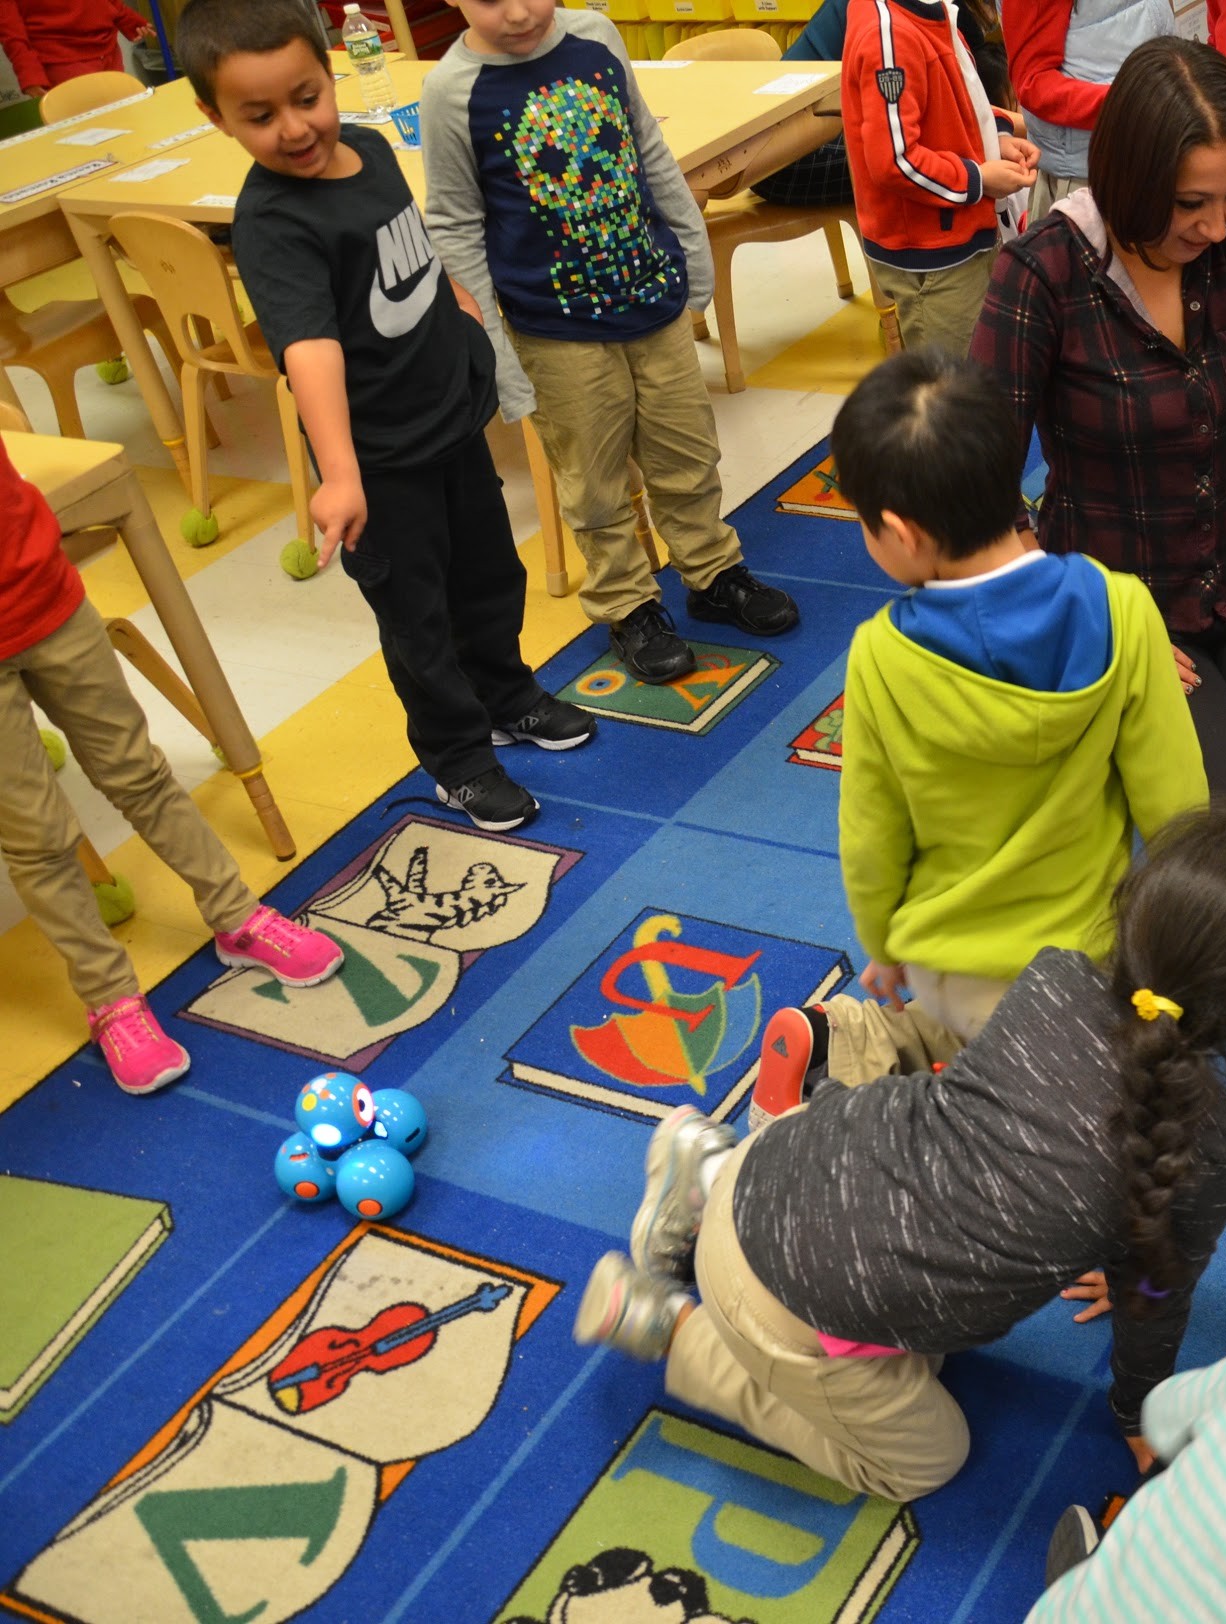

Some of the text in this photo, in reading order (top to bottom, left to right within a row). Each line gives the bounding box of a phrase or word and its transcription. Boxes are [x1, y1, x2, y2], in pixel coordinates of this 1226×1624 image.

[376, 200, 433, 290] NIK
[600, 941, 763, 1033] U
[134, 1466, 347, 1624] V
[610, 1417, 869, 1599] P
